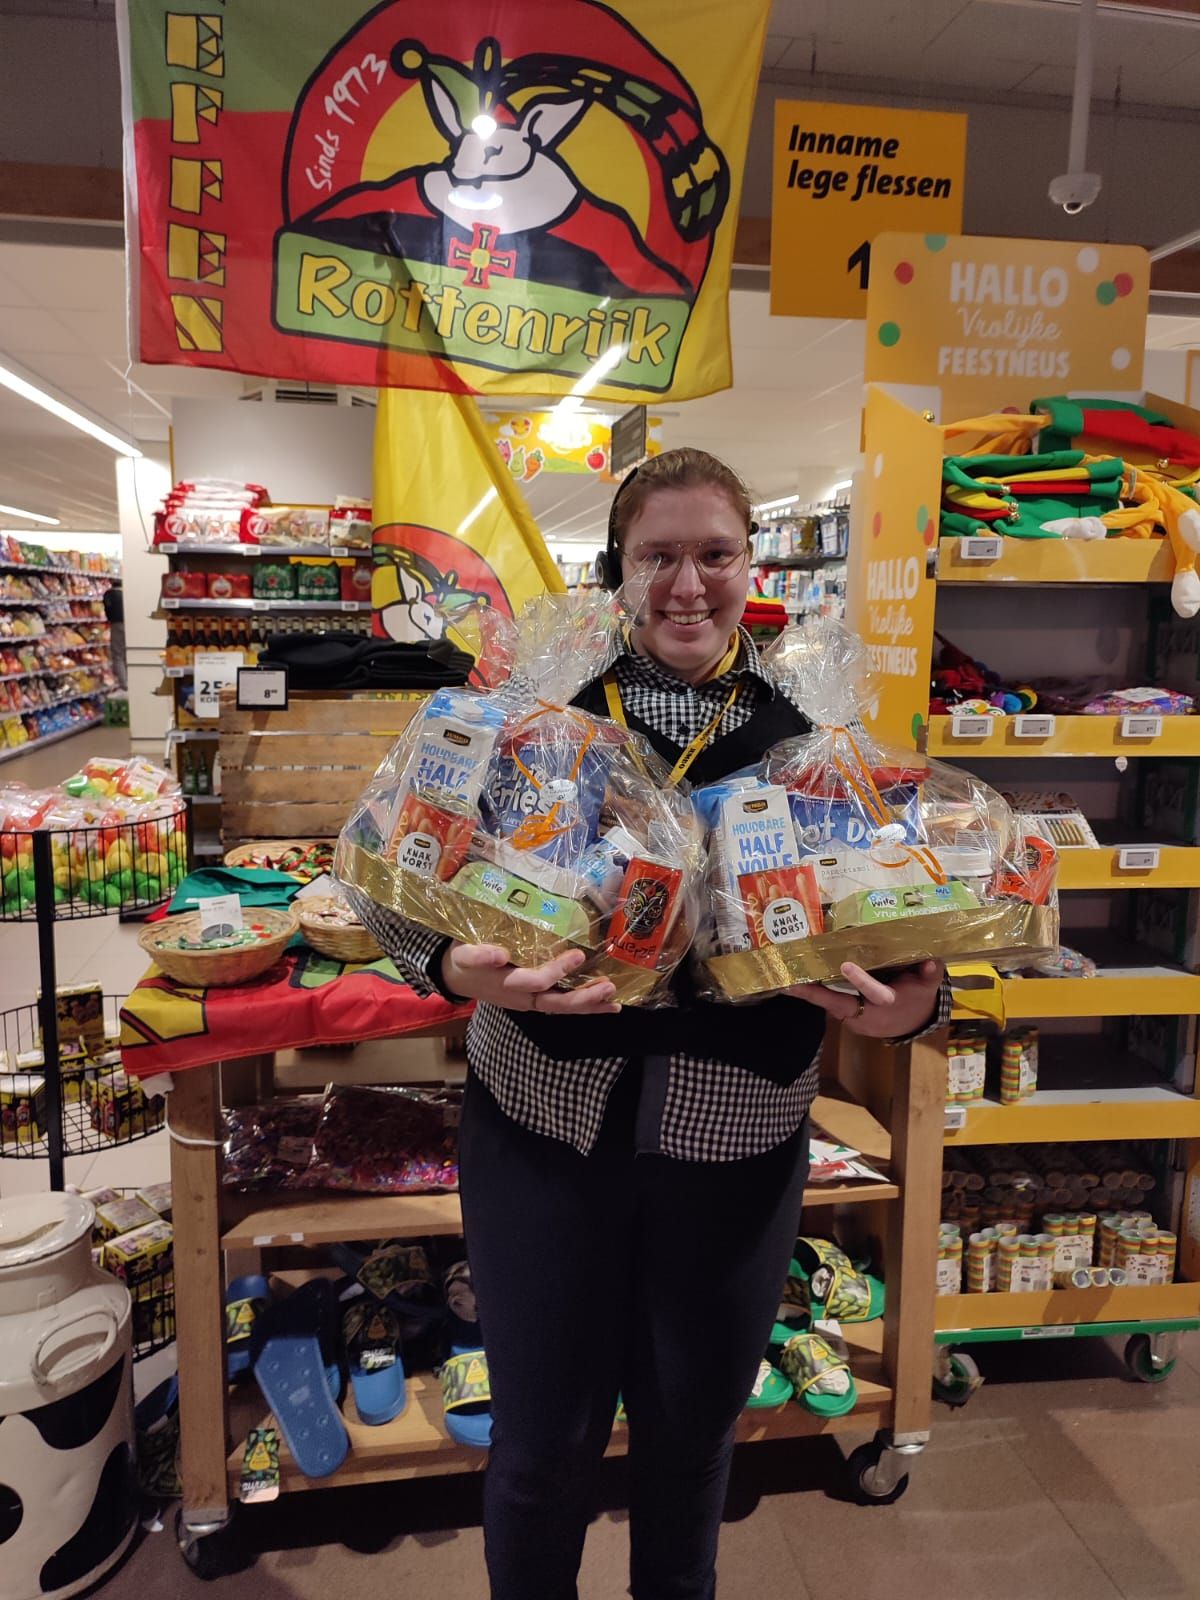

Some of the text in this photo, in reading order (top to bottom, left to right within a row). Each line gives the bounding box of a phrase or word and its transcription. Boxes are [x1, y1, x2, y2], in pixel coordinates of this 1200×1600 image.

[306, 52, 388, 192] Sinds 1973
[788, 124, 900, 159] Inname
[165, 0, 227, 353] EFFEN
[787, 159, 952, 202] lege flessen
[950, 261, 1070, 309] HALLO
[957, 306, 1063, 350] Vrolijke
[937, 345, 1071, 380] FEESTNEUS
[866, 556, 920, 601] HALLO
[731, 817, 786, 837] HOUDBARE
[402, 854, 433, 870] WORST
[406, 847, 432, 862] KNAK
[738, 831, 784, 859] HALF
[771, 921, 806, 939] WORST
[772, 913, 799, 929] KNAK
